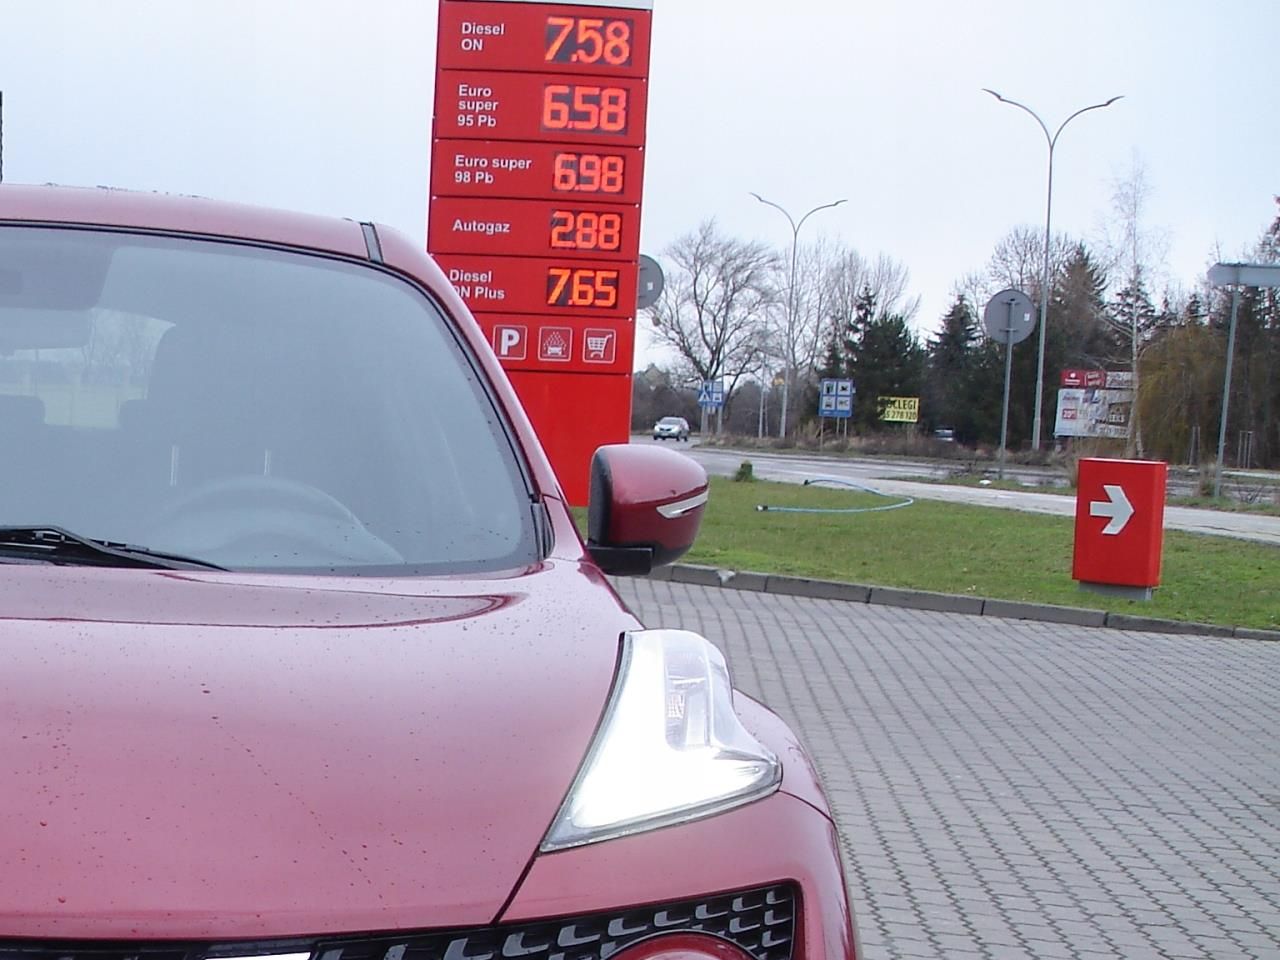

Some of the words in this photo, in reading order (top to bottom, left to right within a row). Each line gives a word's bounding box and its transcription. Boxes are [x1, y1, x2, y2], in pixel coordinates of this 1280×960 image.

[461, 22, 505, 36] Diesel
[461, 39, 484, 52] ON
[545, 16, 631, 65] 7.58
[458, 84, 492, 97] Euro
[458, 100, 499, 113] super
[457, 115, 475, 127] 95
[478, 115, 497, 127] Pb
[454, 155, 488, 168] Euro
[492, 157, 532, 171] super
[454, 171, 472, 184] 98
[475, 171, 494, 184] Pb
[452, 219, 511, 235] Autogaz
[449, 269, 492, 283] Diesel
[474, 286, 505, 300] Plus
[500, 329, 520, 356] P
